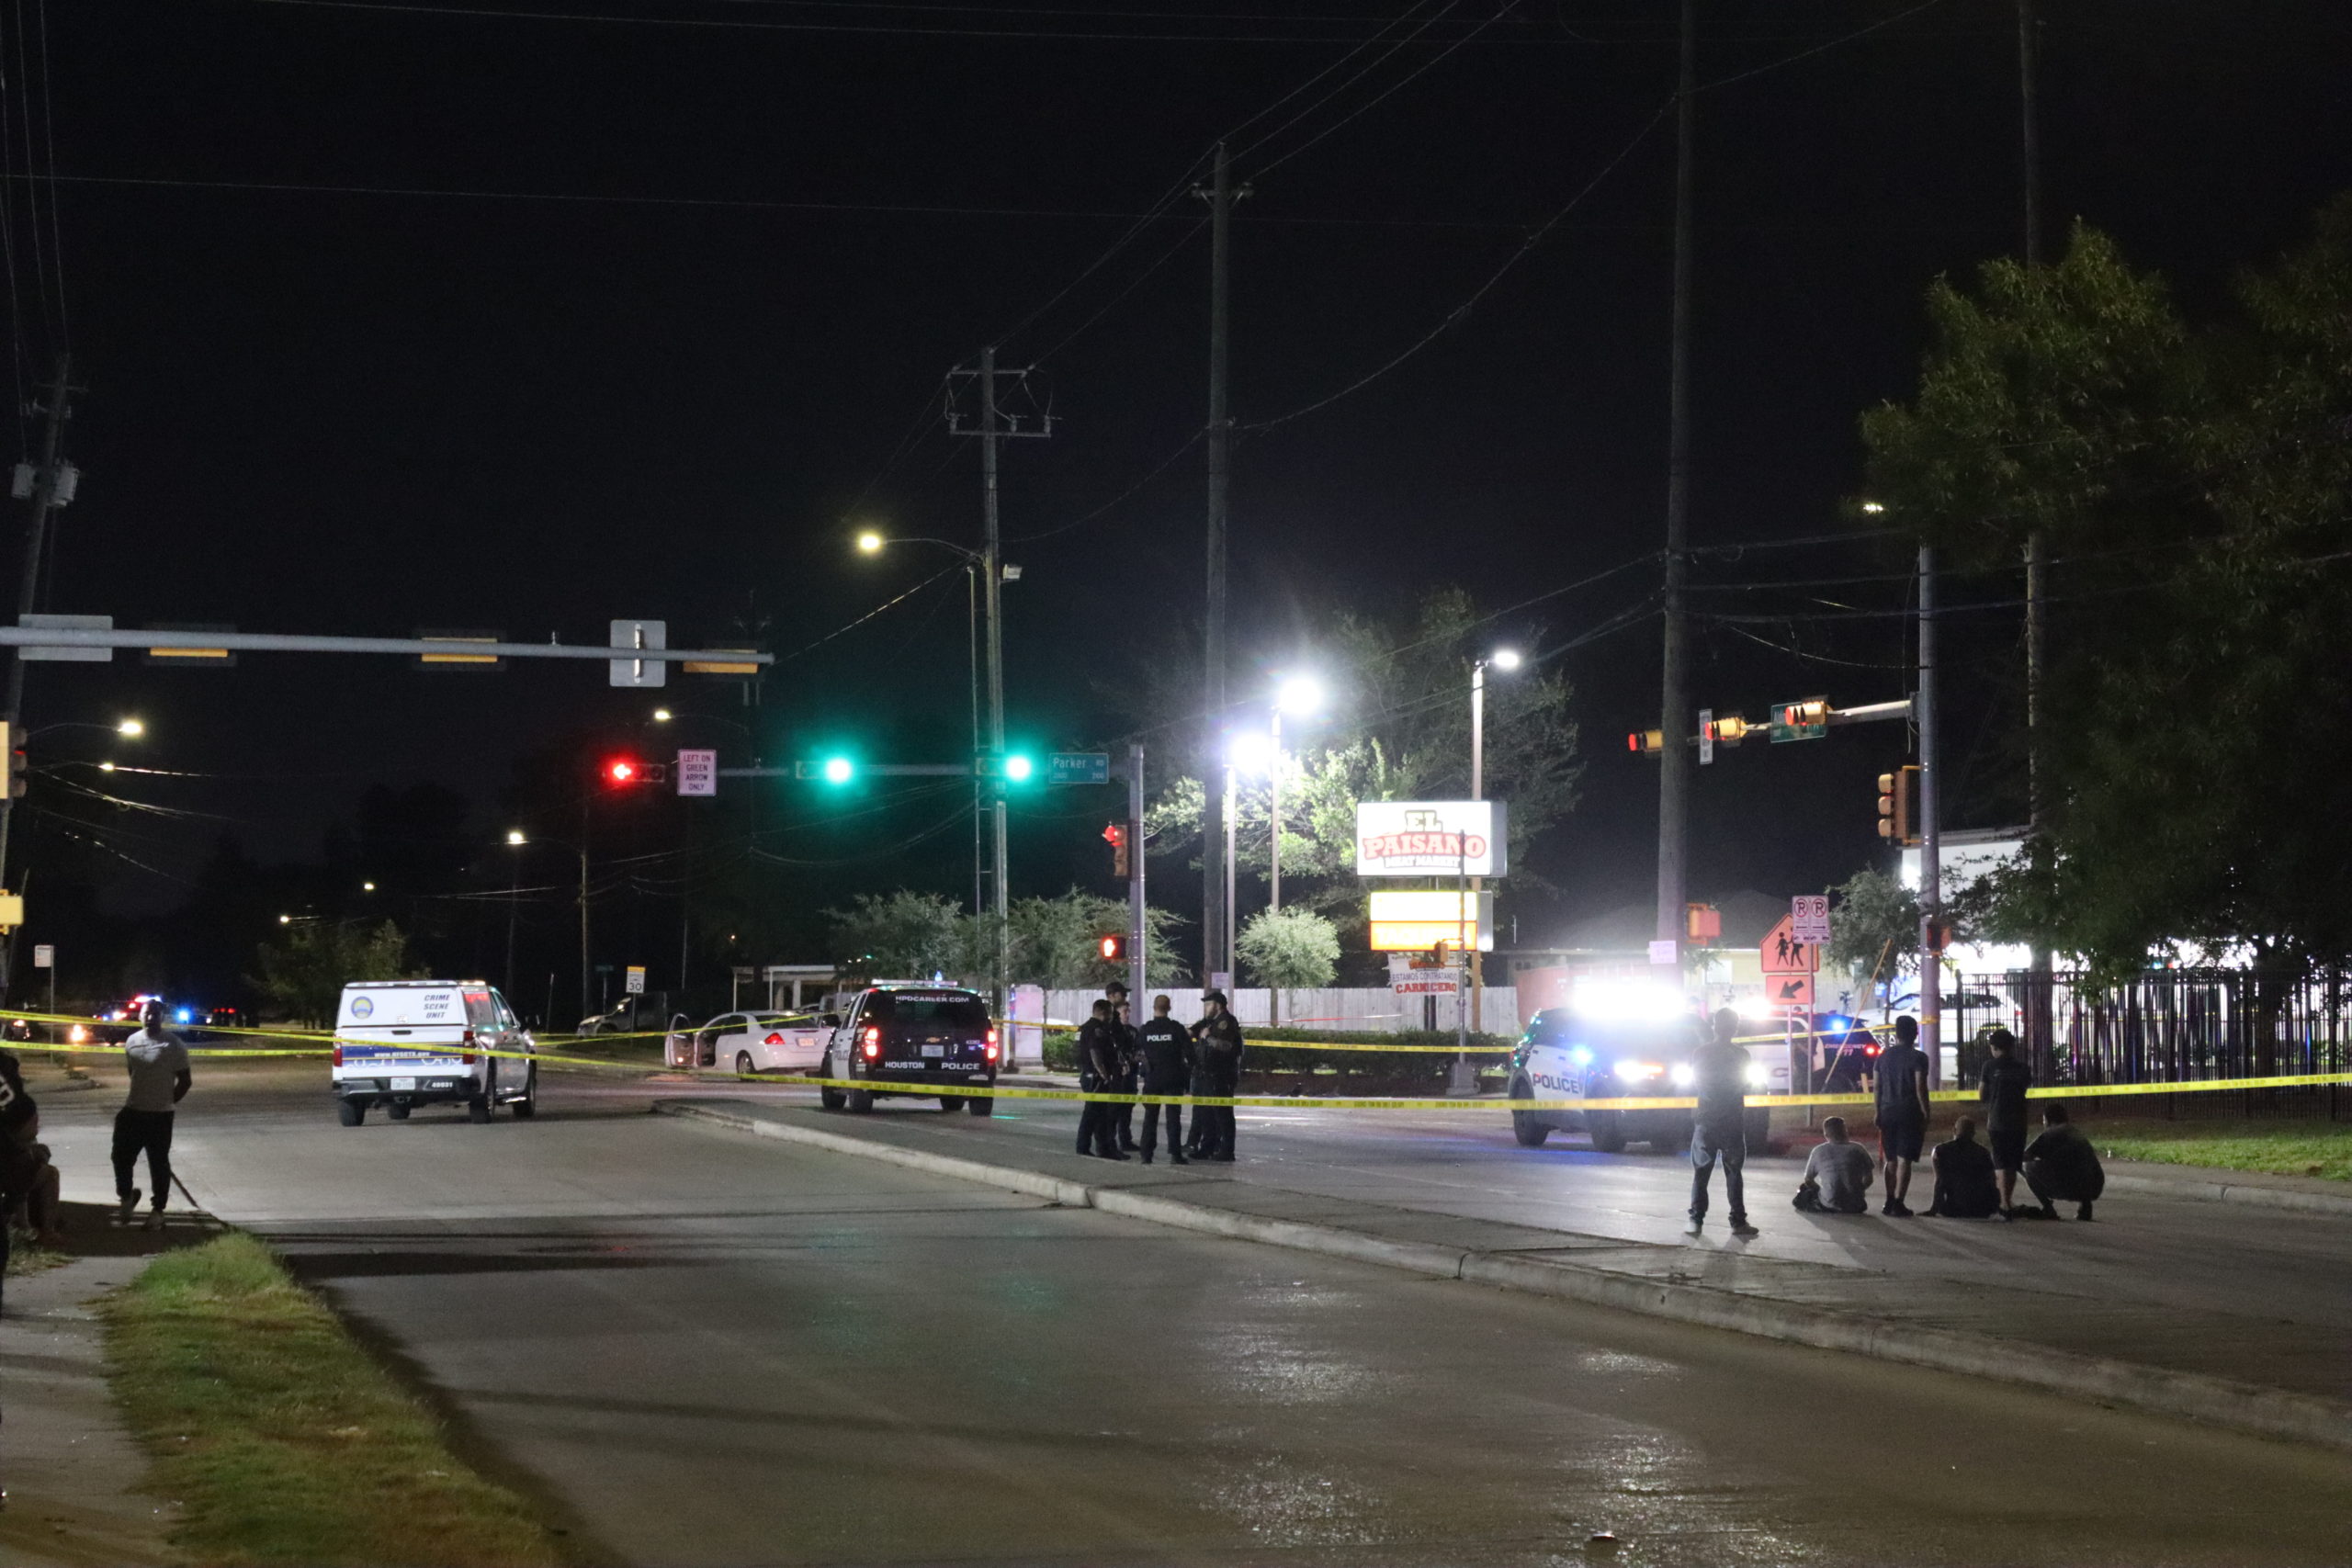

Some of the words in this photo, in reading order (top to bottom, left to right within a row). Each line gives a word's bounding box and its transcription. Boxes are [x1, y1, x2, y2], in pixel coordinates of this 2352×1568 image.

[683, 754, 698, 762] LEFT
[1053, 757, 1087, 769] Parker
[688, 783, 705, 791] ONLY
[1406, 809, 1443, 832] EL
[1363, 831, 1487, 860] PAISANO
[1392, 972, 1419, 982] ESTAMOS
[628, 982, 642, 991] 30
[1396, 982, 1457, 994] CARNICERO
[424, 1002, 449, 1010] SCENE
[1147, 1033, 1172, 1043] POLICE
[885, 1061, 925, 1069] HOUSTON
[941, 1062, 980, 1070] POLICE
[1532, 1073, 1579, 1094] POLICE
